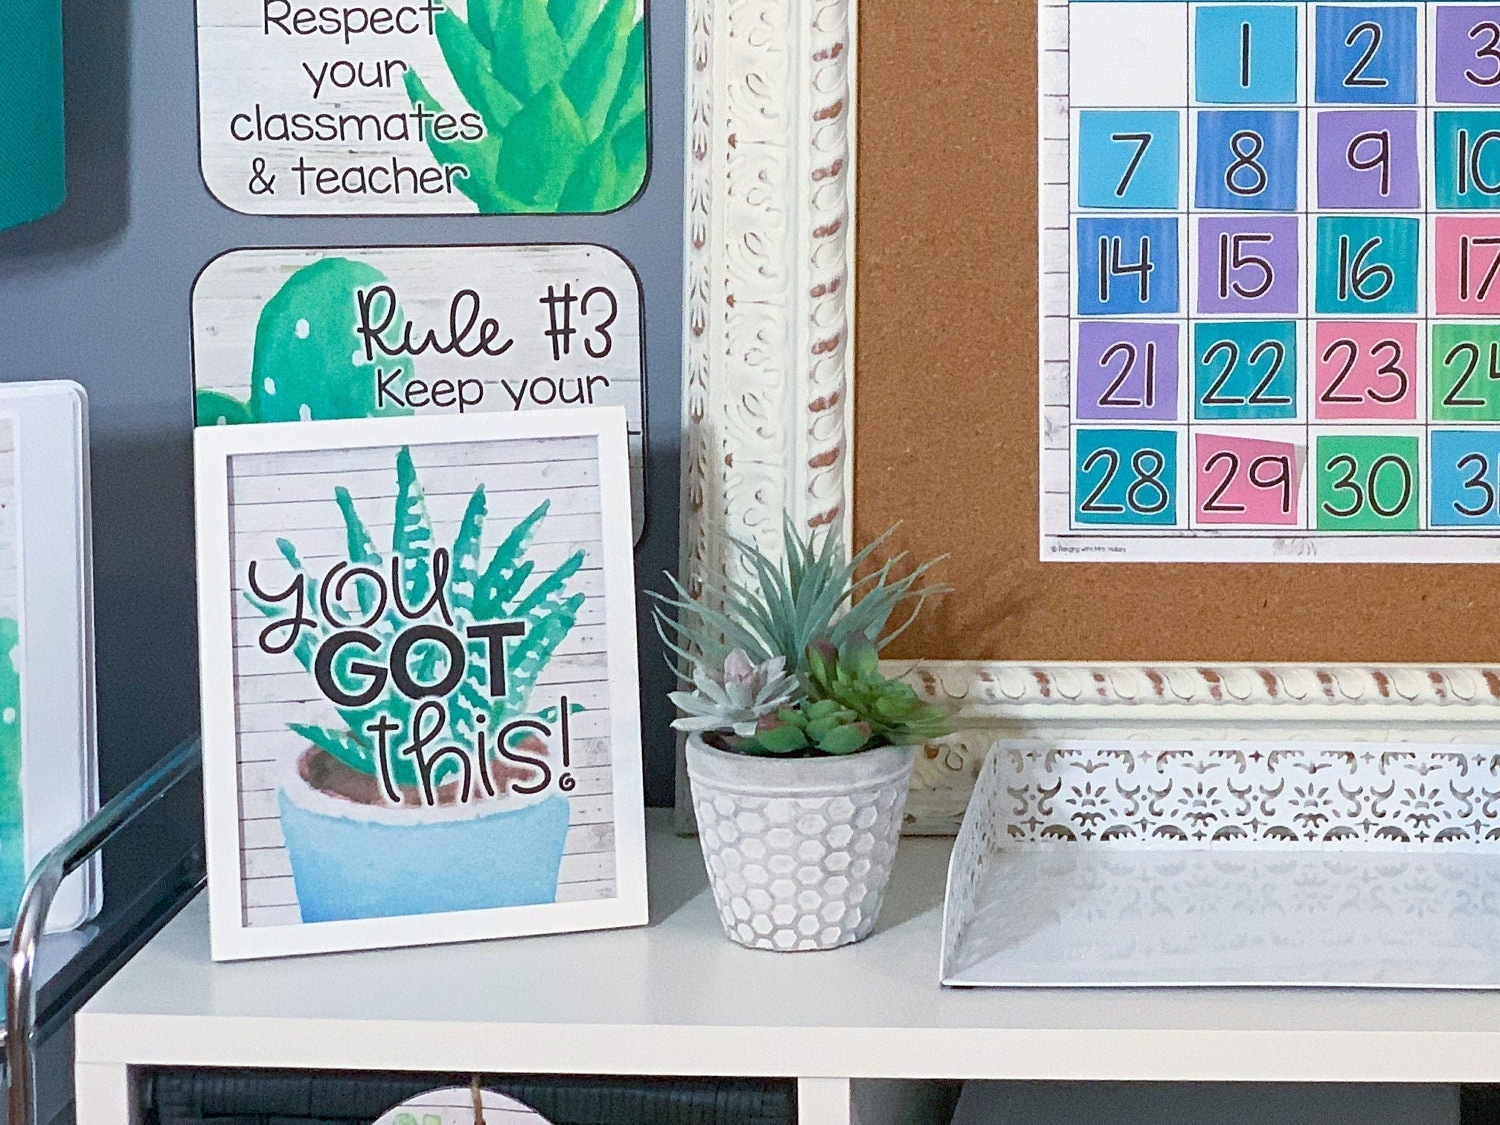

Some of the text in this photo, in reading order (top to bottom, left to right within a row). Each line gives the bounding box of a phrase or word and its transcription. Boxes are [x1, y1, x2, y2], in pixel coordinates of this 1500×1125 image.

[302, 60, 408, 99] your
[1240, 22, 1250, 88] 1
[1345, 22, 1388, 87] 2
[230, 104, 485, 142] classmates
[248, 158, 470, 196] & teacher
[1111, 133, 1153, 197] 7
[1224, 130, 1268, 196] 8
[1346, 130, 1390, 196] 9
[1100, 236, 1154, 302] 14
[1220, 233, 1274, 298] 15
[1338, 236, 1394, 301] 16
[356, 283, 619, 362] Rule #3
[376, 368, 610, 413] Keep your
[1099, 342, 1155, 407] 21
[1201, 340, 1292, 405] 22
[1320, 339, 1408, 403] 23
[1081, 448, 1169, 513] 28
[1202, 452, 1290, 513] 29
[1322, 454, 1413, 518] 30
[248, 547, 454, 655] you
[314, 621, 526, 707] GOT
[366, 696, 577, 806] this!
